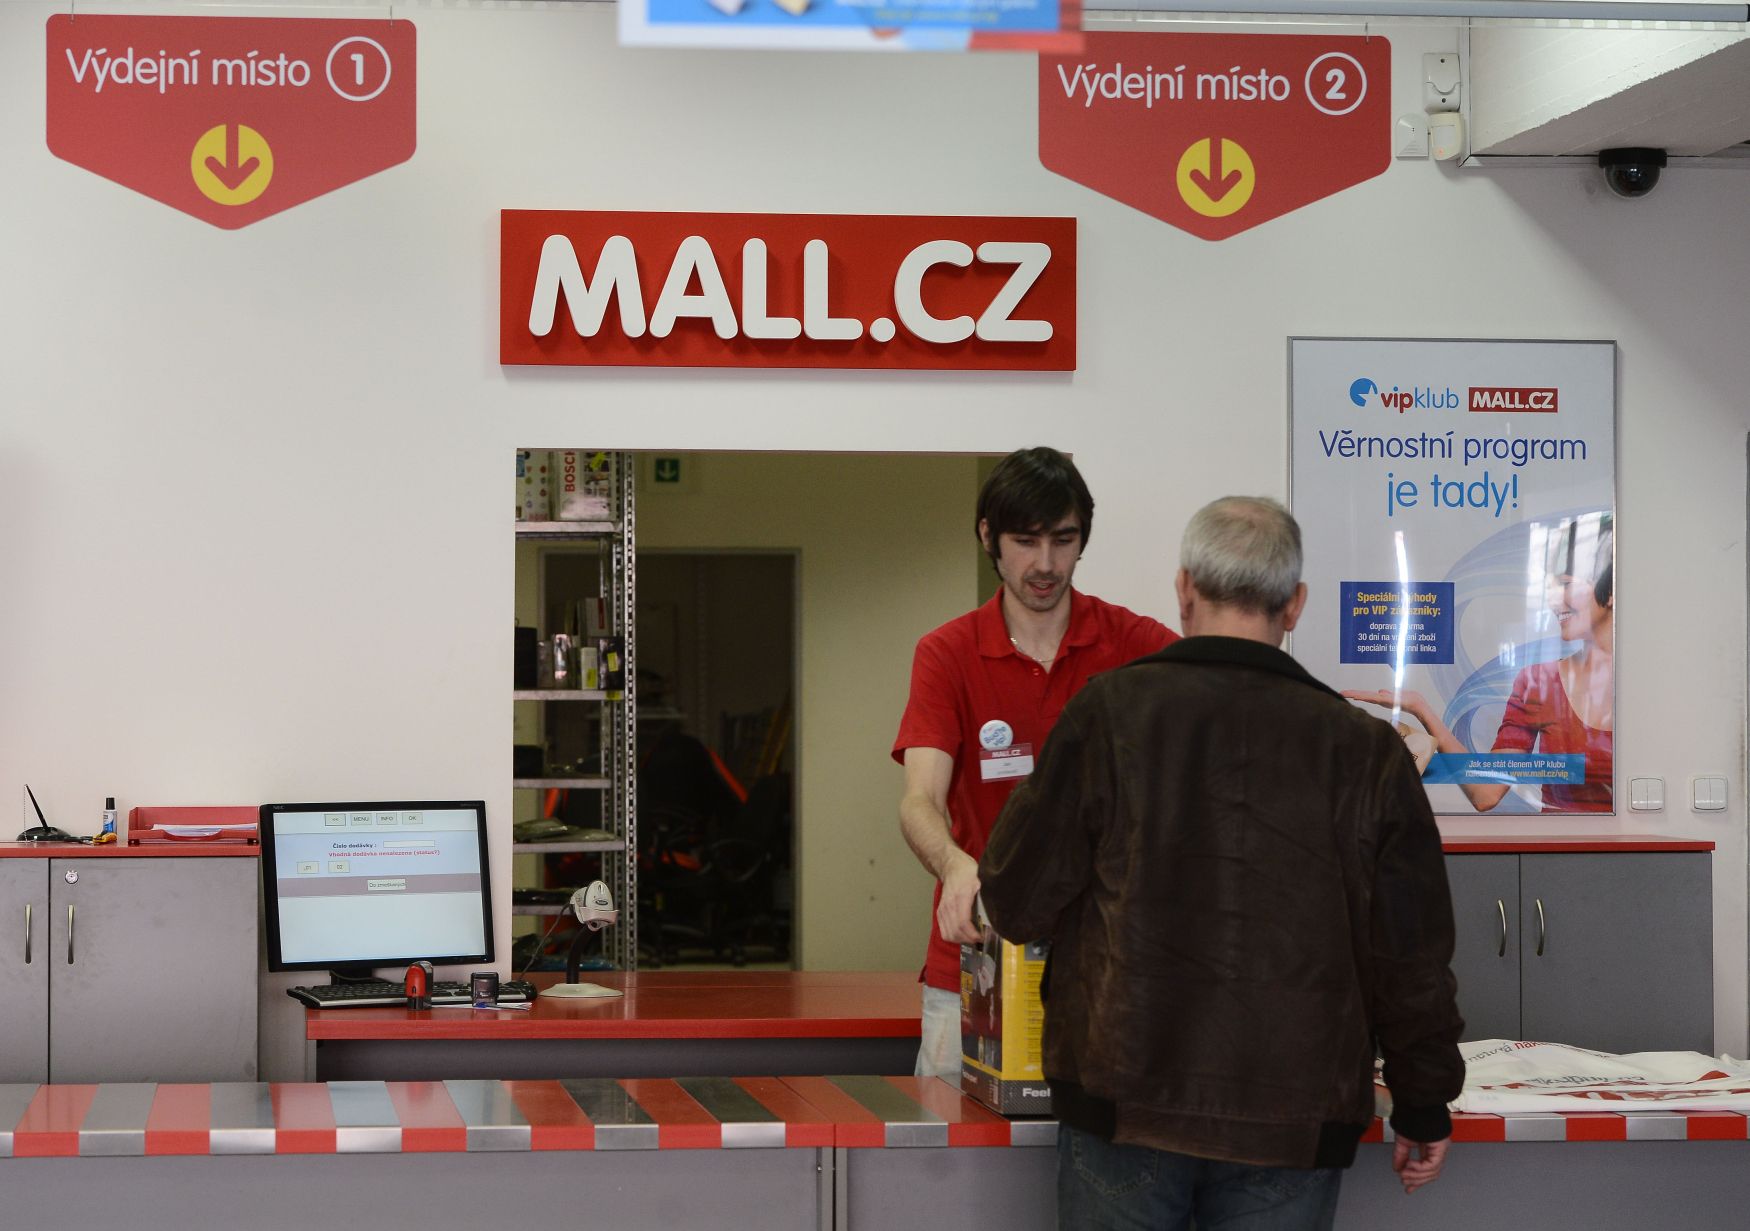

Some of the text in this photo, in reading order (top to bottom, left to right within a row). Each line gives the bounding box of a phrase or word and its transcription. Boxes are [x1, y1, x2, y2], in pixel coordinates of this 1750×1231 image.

[66, 48, 364, 94] Výdejní místo 1
[1057, 62, 1346, 108] Výdejní místo 2
[528, 234, 1054, 344] MALL.CZ
[1380, 386, 1554, 413] vipklub MALL.CZ
[1319, 429, 1587, 467] Věrnostní program
[1388, 471, 1518, 517] je tady!
[1353, 607, 1369, 616] pro
[1372, 606, 1388, 615] VIP
[1402, 592, 1437, 604] ýhody
[1357, 633, 1368, 641] 30
[1468, 760, 1481, 768] Jak
[1507, 760, 1532, 768] členem
[1534, 760, 1546, 768] VIP
[1022, 1087, 1051, 1098] Feel
